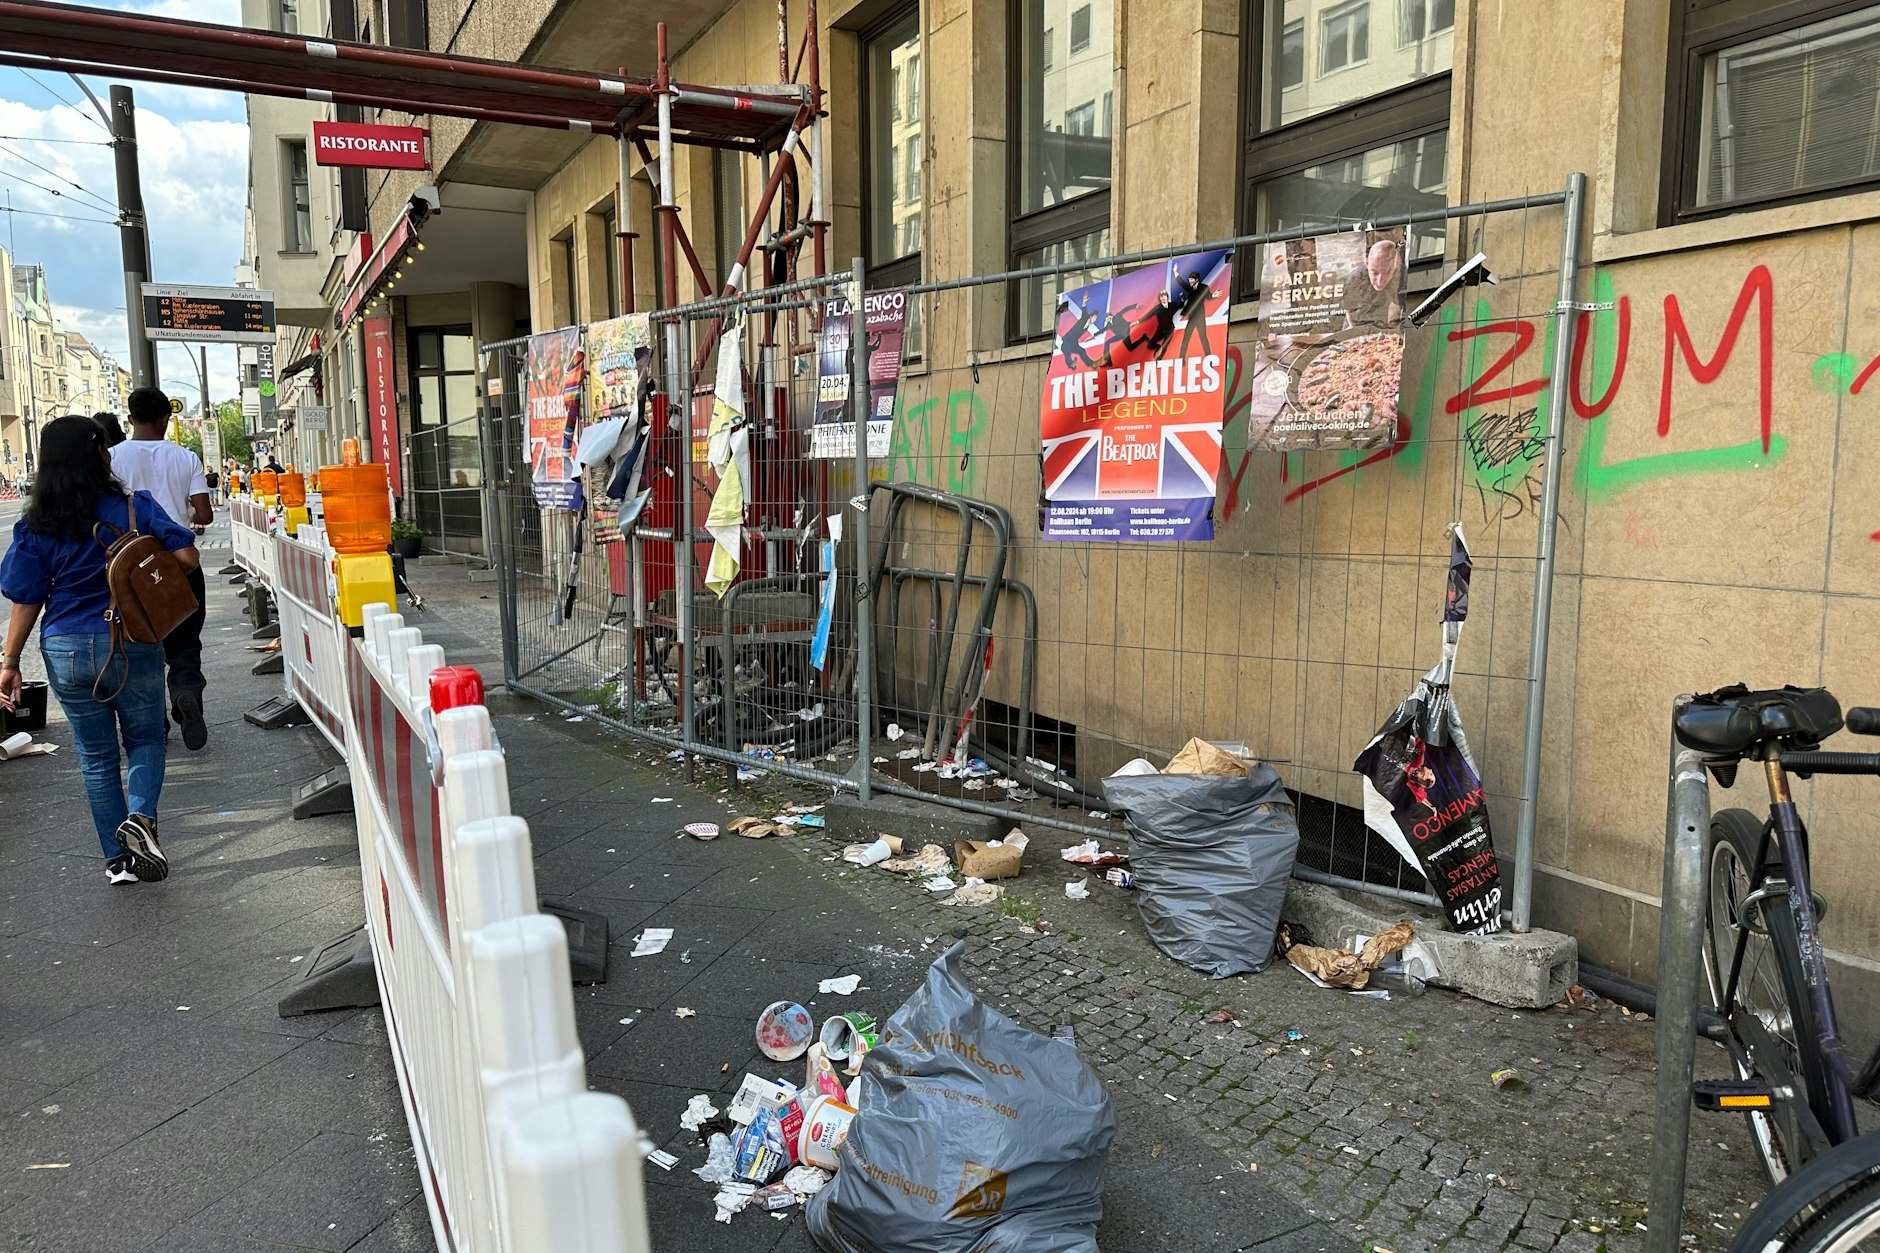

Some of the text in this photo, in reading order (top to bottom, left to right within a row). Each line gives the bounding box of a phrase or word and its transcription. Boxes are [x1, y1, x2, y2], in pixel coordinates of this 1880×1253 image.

[320, 135, 419, 154] RISTORANTE
[1273, 270, 1333, 288] PARTY-
[1271, 283, 1344, 304] SERVICE
[826, 292, 905, 317] FLAENCO
[1270, 306, 1308, 315] Hausgemachte
[866, 310, 904, 324] azabache
[1305, 310, 1329, 318] Rezepten
[1281, 320, 1301, 328] Spanier
[160, 331, 222, 339] Naturkundemuseum
[821, 377, 847, 388] 20.04.
[1051, 371, 1099, 410] THE
[1107, 354, 1221, 400] BEATLES
[304, 410, 324, 418] GOLD
[1082, 397, 1188, 423] LEGEND
[1279, 410, 1366, 422] Jetzt buchen:
[376, 345, 392, 492] RISTORANTE
[818, 423, 887, 437] PHILHARONIE
[1273, 421, 1370, 433] paellalivecooking.de
[1125, 434, 1136, 442] THE
[1102, 435, 1159, 465] BEATBOX
[1050, 508, 1079, 516] 12.08.2024
[1087, 507, 1103, 515] 19:00
[1103, 507, 1114, 515] Uhr
[1130, 507, 1165, 515] Tickets unter
[1049, 517, 1074, 525] Ballhaus
[1130, 517, 1191, 525] www.ballhaus-berlin.de
[1412, 787, 1486, 840] AMENCO
[1462, 825, 1484, 839] Ramón
[1463, 832, 1487, 849] mit dem
[1447, 847, 1495, 883] MENCAS
[1446, 863, 1498, 901] ANTASIAS
[820, 1121, 833, 1148] CREME
[826, 1122, 839, 1151] JOGHURT
